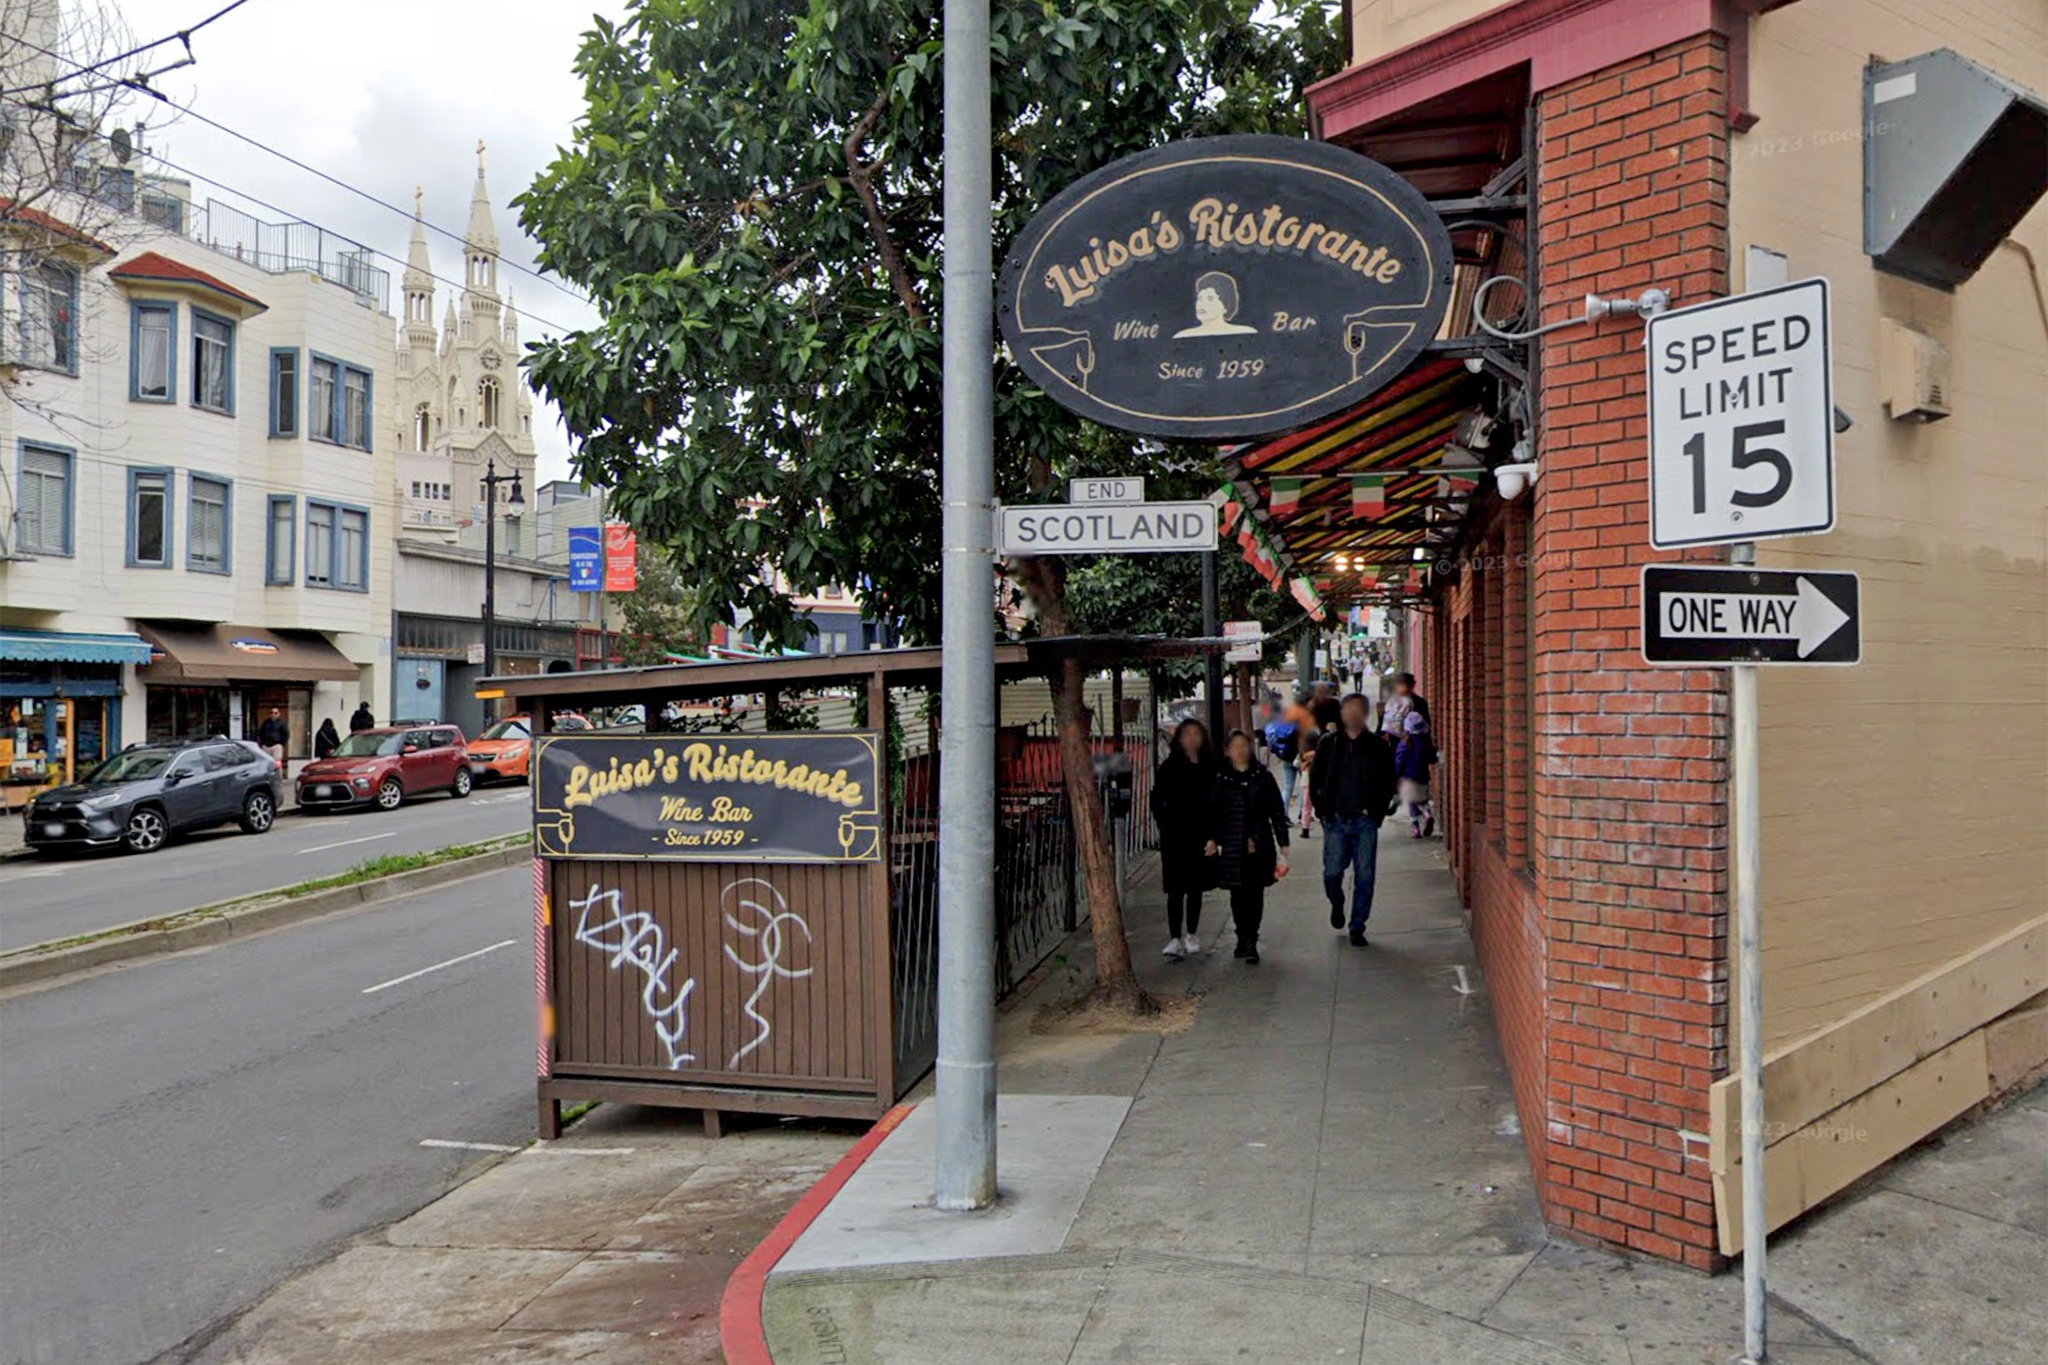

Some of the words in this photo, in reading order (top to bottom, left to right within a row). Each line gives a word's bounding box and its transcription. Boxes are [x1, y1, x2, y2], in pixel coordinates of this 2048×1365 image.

[1044, 212, 1179, 308] Luisa's
[1189, 197, 1402, 285] Ristorante
[1114, 320, 1159, 341] Wine
[1273, 311, 1316, 333] Bar
[1664, 315, 1811, 374] SPEED
[1158, 361, 1203, 380] Since
[1217, 359, 1264, 380] 1959
[1680, 367, 1793, 420] LIMIT
[1683, 419, 1793, 514] 15
[1087, 482, 1125, 499] END
[1018, 513, 1205, 542] SCOTLAND
[1668, 597, 1728, 633] ONE
[1739, 599, 1797, 634] WAY
[564, 747, 679, 807] Luisa's
[683, 742, 863, 806] Ristorante
[658, 796, 704, 822] Wine
[708, 796, 753, 822] Bar
[664, 830, 701, 846] Since
[704, 829, 745, 846] 1959
